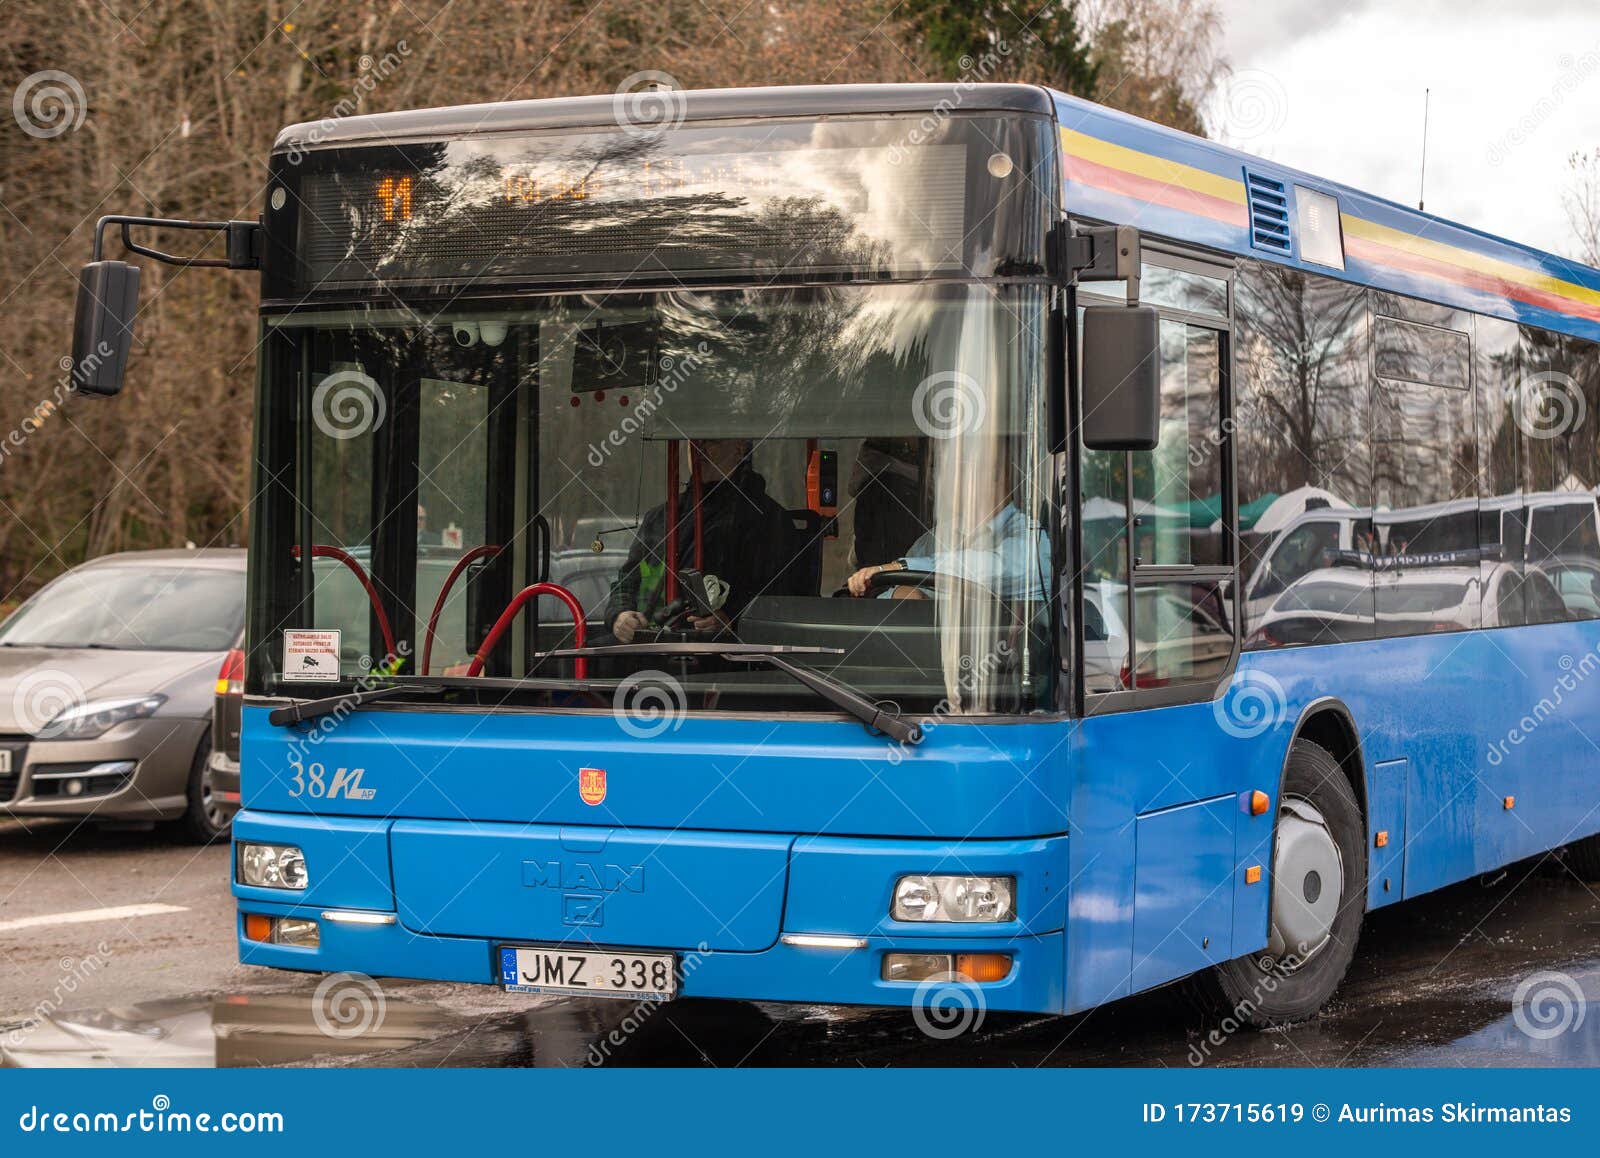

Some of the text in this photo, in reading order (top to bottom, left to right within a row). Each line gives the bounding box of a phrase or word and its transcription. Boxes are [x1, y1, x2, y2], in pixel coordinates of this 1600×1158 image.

[378, 177, 410, 221] 11
[287, 762, 325, 798] 38
[521, 859, 645, 893] MAN
[503, 971, 516, 981] LT
[522, 954, 669, 991] JMZ 338
